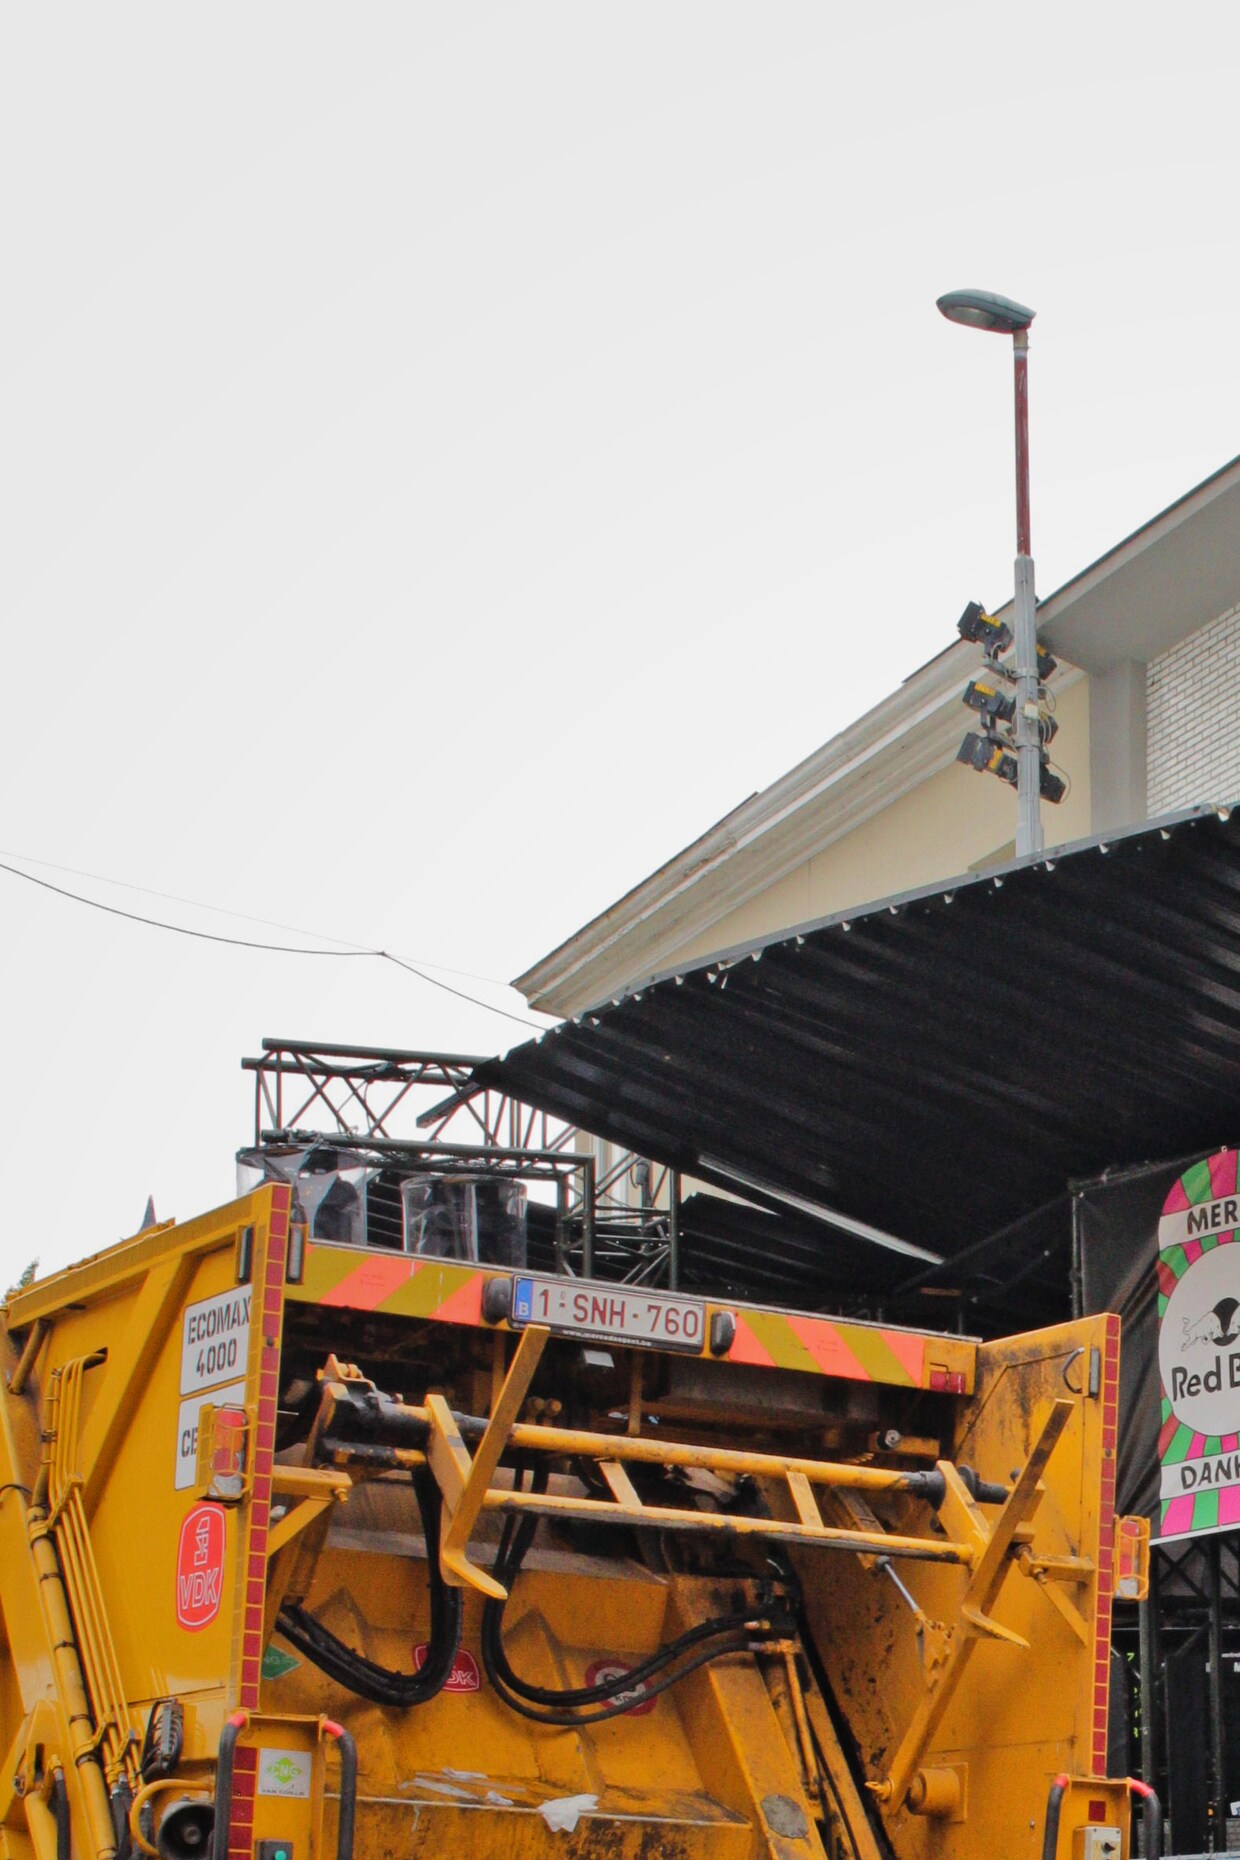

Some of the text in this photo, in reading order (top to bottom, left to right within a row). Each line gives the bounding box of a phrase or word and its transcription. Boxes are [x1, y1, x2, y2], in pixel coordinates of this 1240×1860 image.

[187, 1296, 251, 1345] ECOMAX
[518, 1301, 530, 1317] B
[196, 1338, 237, 1377] 4000
[1172, 1355, 1221, 1402] Red
[179, 1567, 220, 1610] VDK
